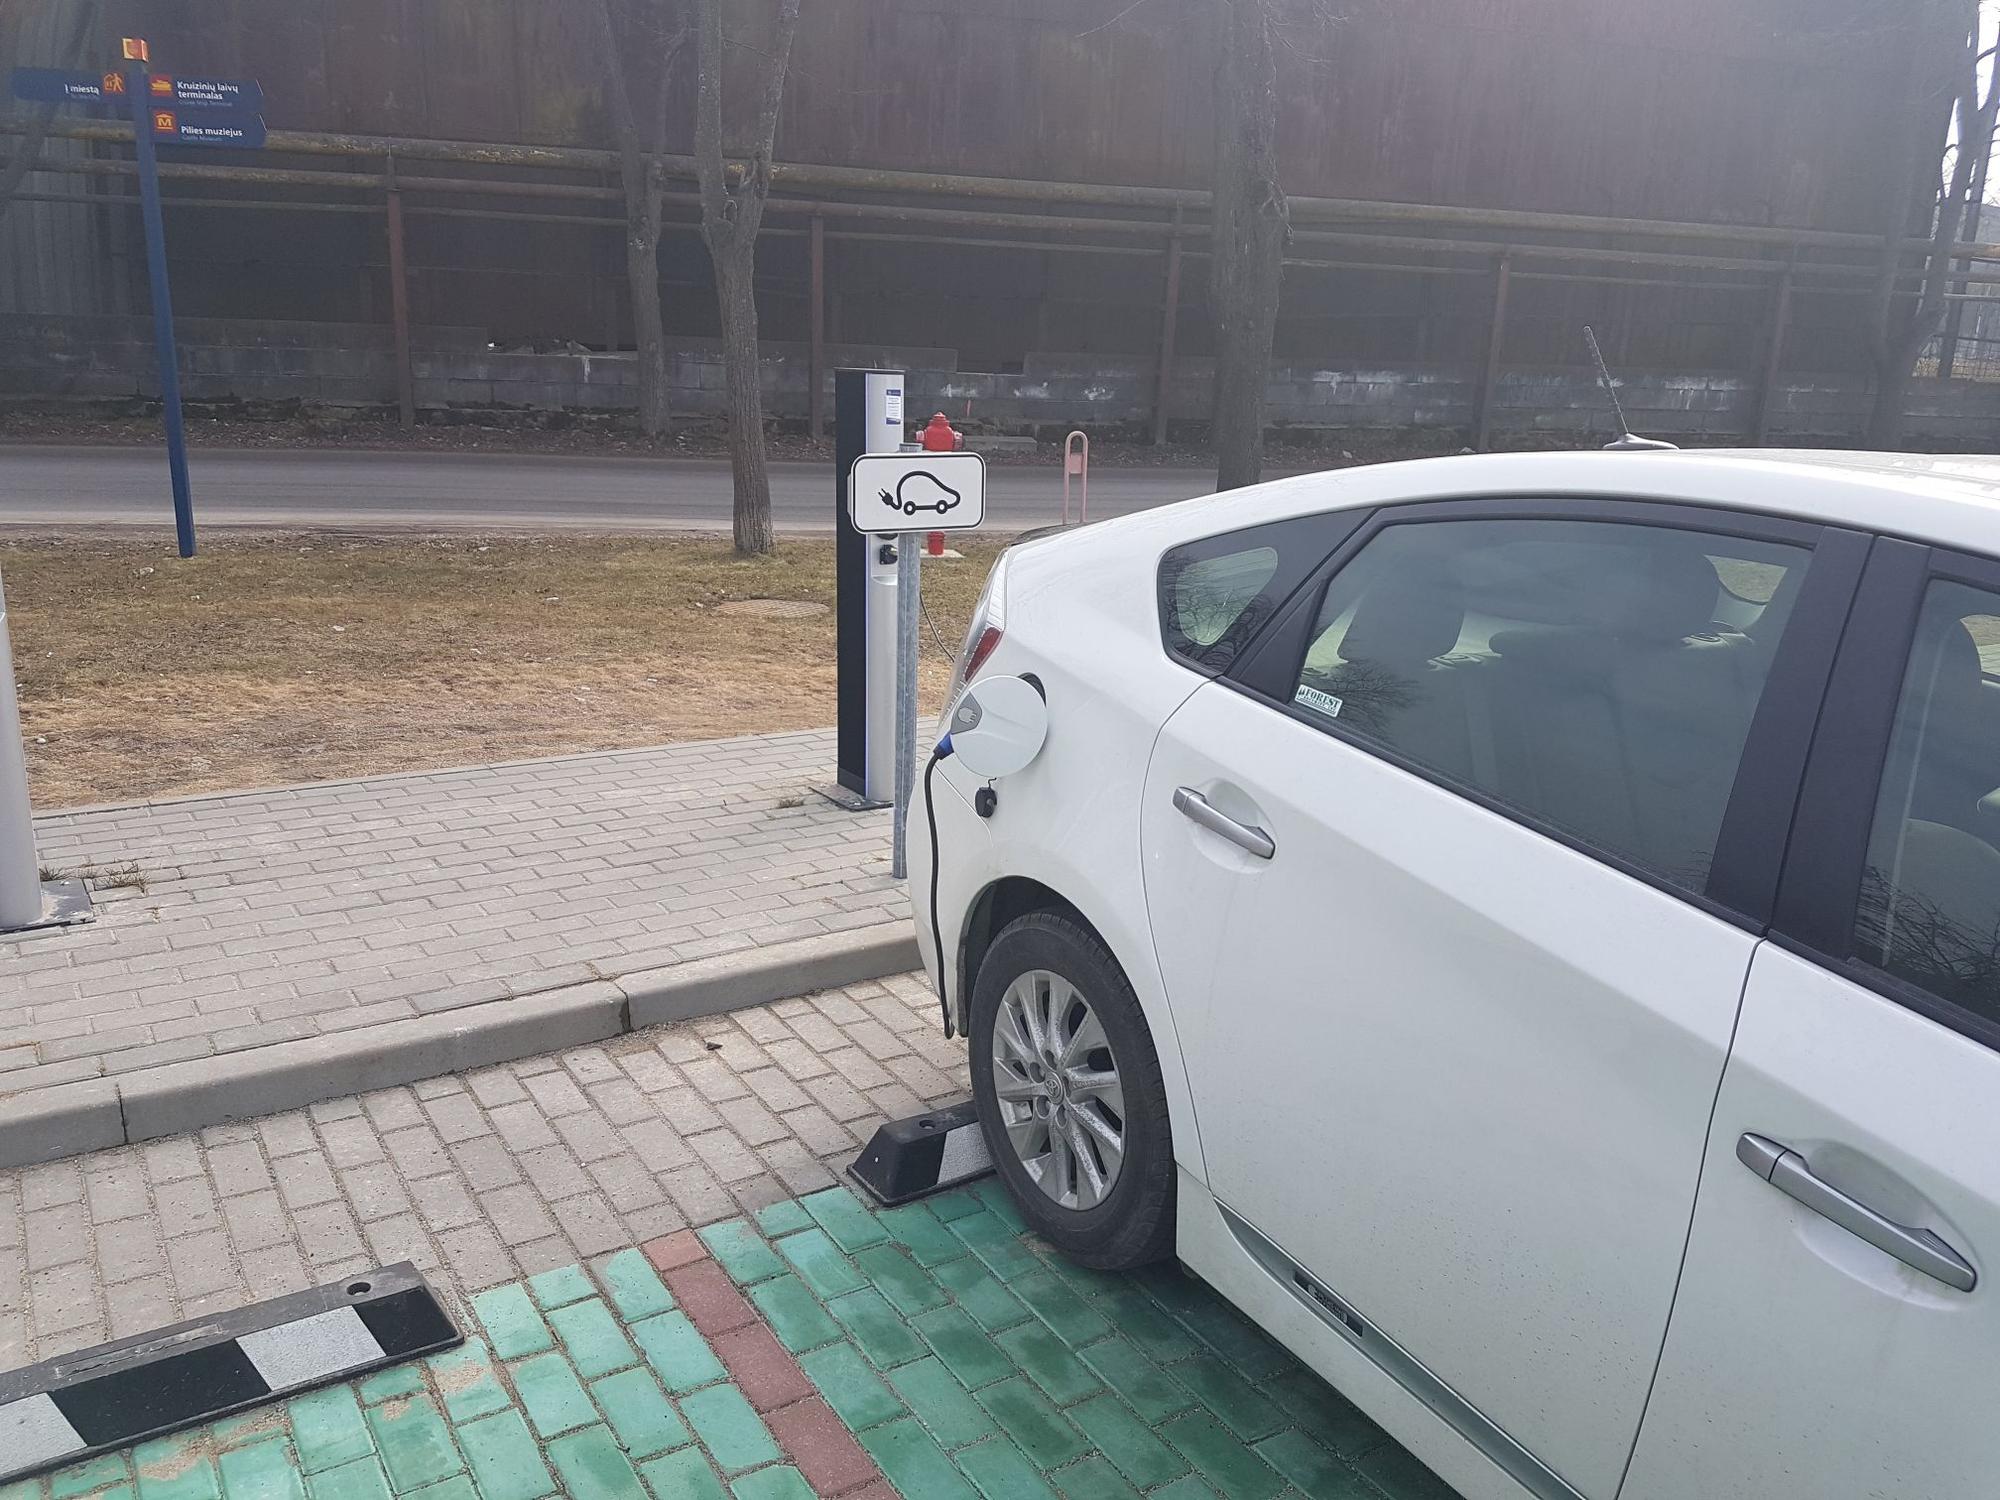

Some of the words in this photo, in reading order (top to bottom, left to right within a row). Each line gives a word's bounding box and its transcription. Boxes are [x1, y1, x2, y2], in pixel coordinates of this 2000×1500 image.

[178, 90, 223, 100] terminalas
[181, 125, 204, 135] Pilies
[205, 127, 243, 138] muziejus
[1306, 688, 1340, 708] FOREST
